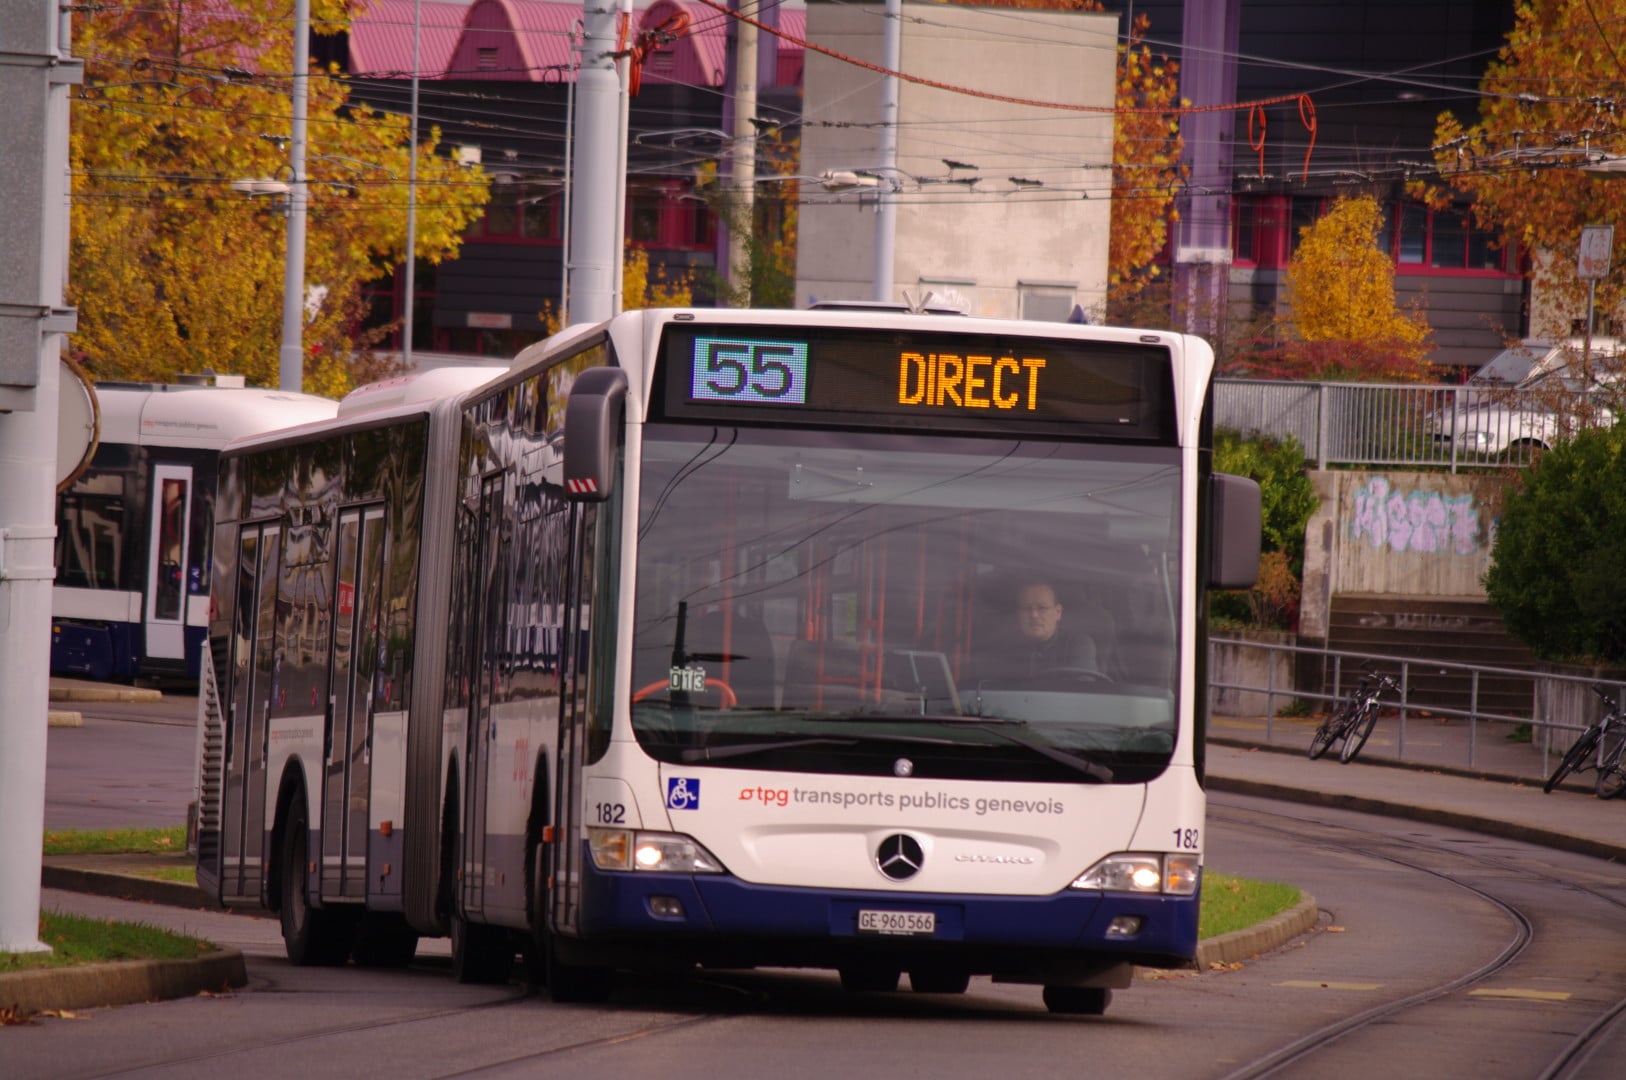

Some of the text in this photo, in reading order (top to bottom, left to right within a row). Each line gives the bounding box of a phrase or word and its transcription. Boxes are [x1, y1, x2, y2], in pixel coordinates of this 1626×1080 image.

[706, 343, 795, 399] 55
[899, 352, 1046, 410] DIRECT
[595, 803, 625, 824] 182
[793, 787, 895, 808] transports
[899, 791, 970, 811] publics
[975, 797, 1064, 815] genevois
[1172, 827, 1199, 849] 182
